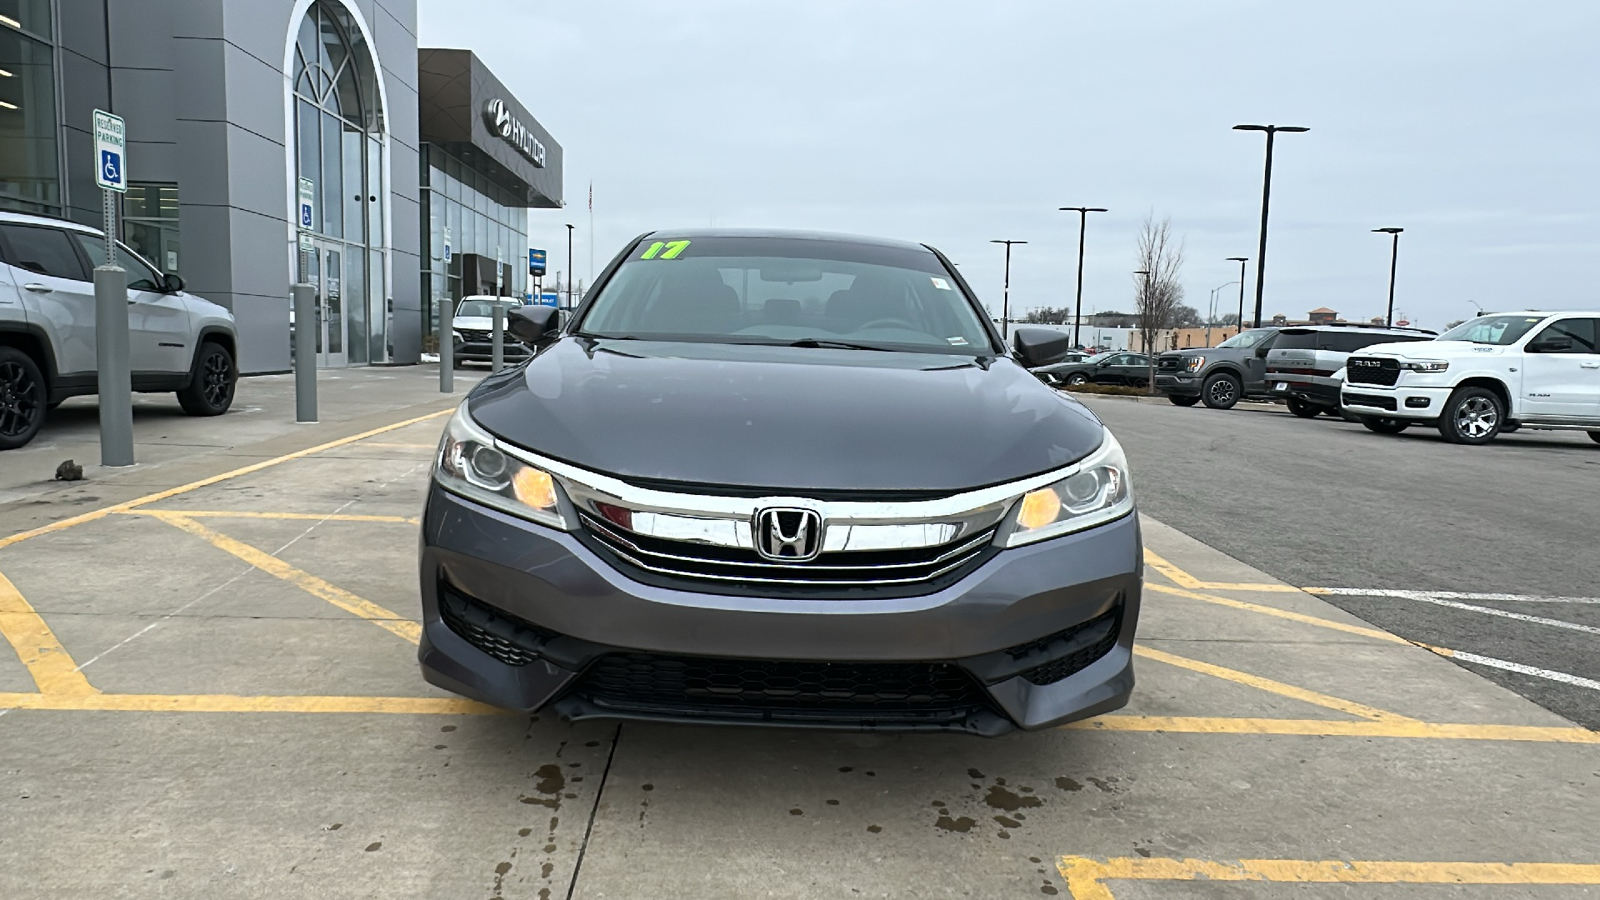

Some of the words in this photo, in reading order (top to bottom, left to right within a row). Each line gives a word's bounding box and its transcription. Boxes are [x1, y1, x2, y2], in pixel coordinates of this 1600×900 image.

[97, 118, 123, 135] RESERVED
[98, 131, 123, 148] PARKING
[512, 116, 546, 168] HYUNDAI
[640, 240, 692, 260] 17
[1354, 360, 1381, 368] RAM
